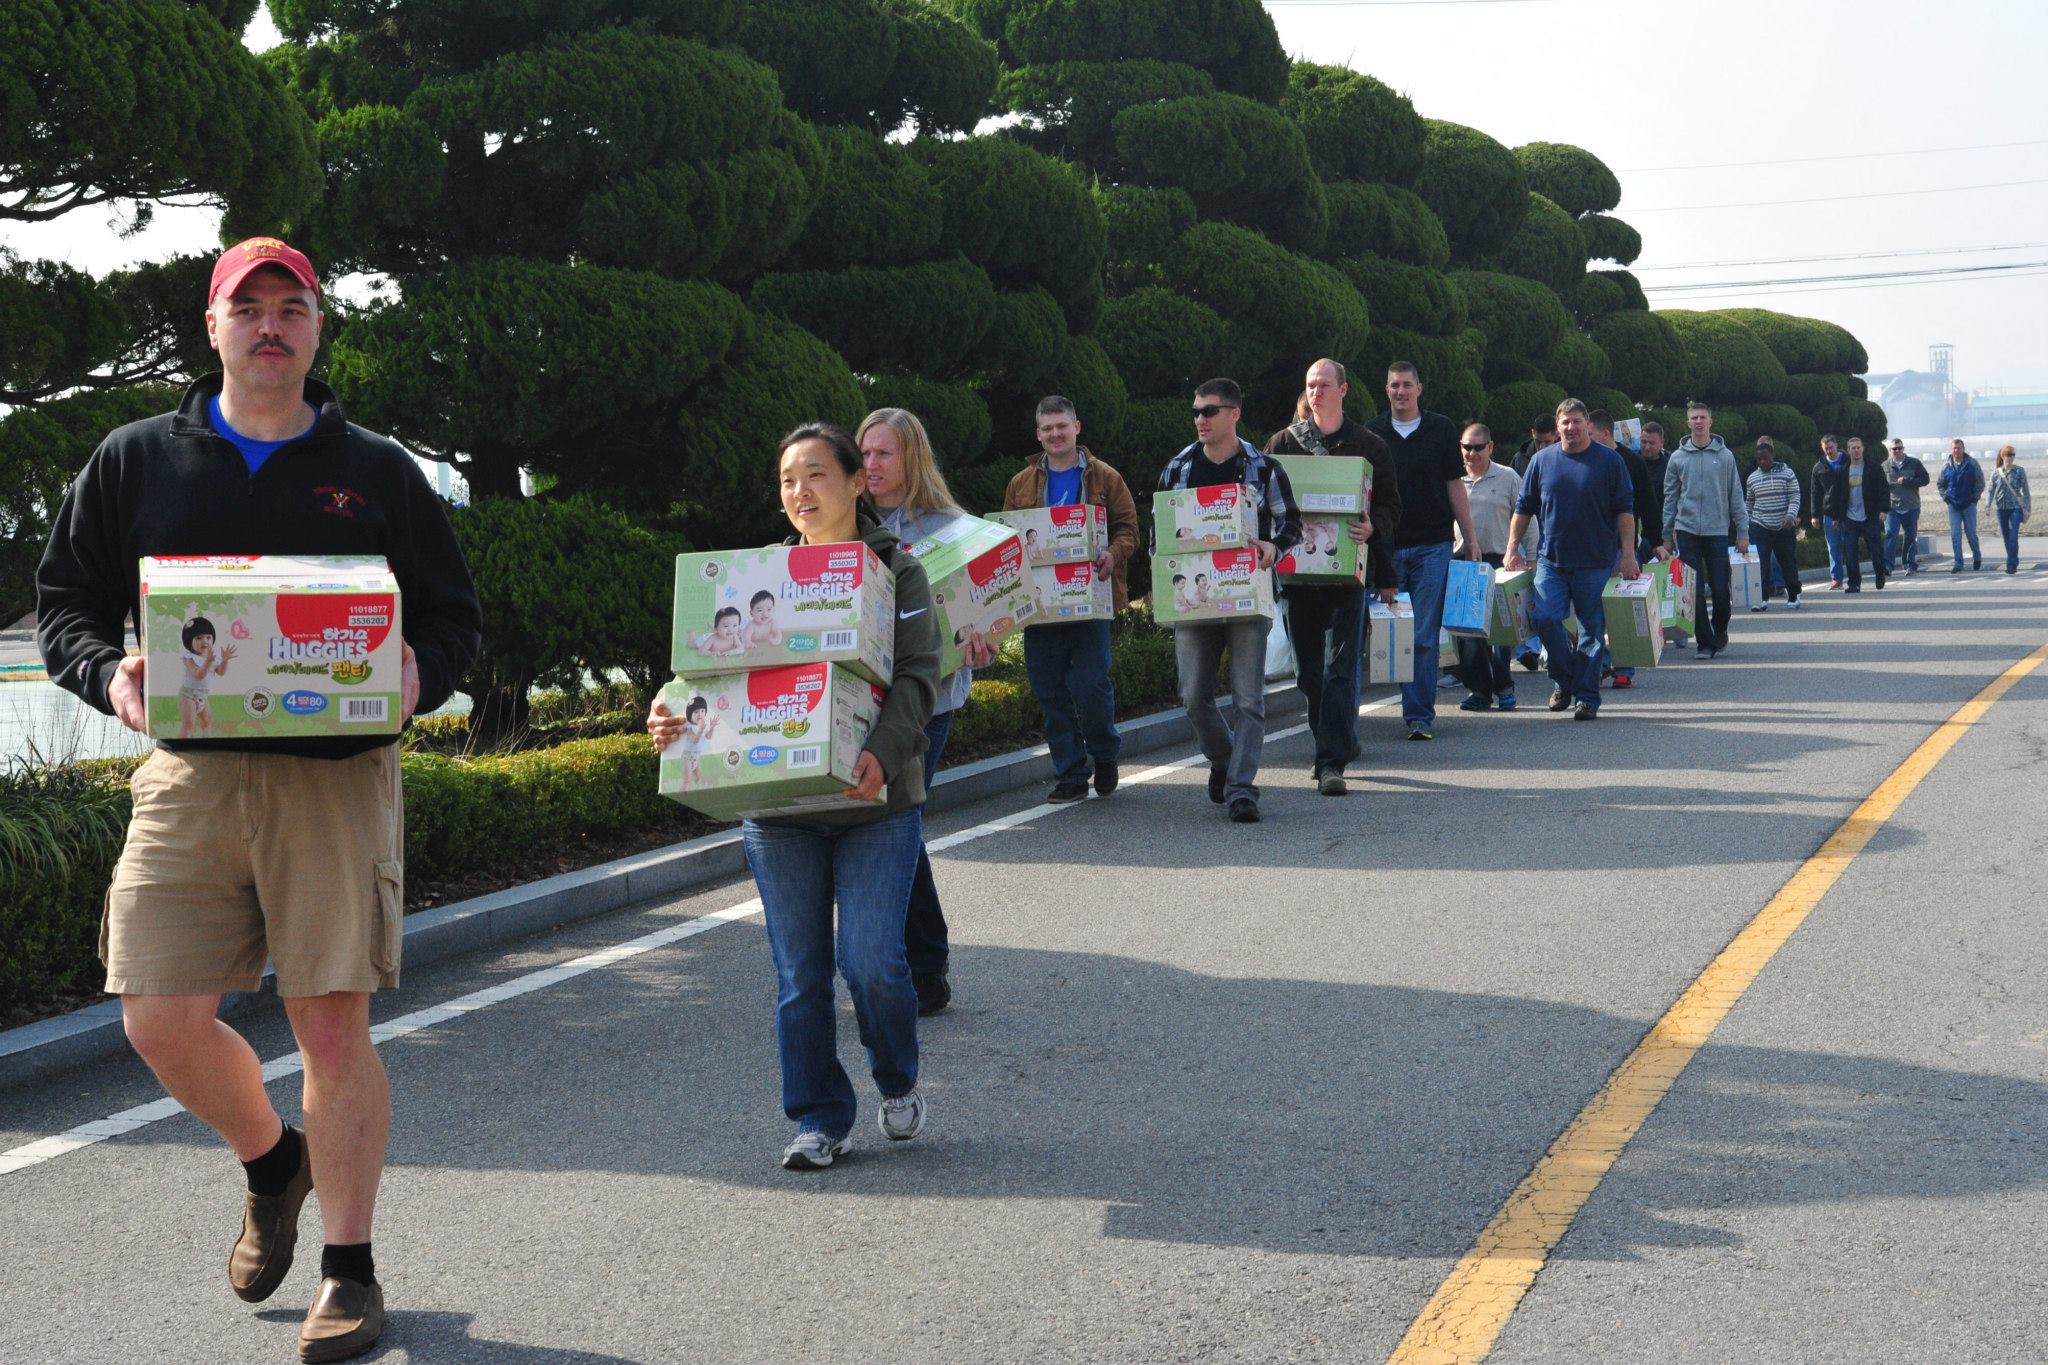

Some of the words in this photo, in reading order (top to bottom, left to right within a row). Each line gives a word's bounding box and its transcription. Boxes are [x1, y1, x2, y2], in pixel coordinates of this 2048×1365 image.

[1194, 504, 1232, 515] HUGGIES
[1050, 523, 1082, 534] HUGGIES
[820, 571, 854, 583] 하기스
[1210, 568, 1250, 580] HUGGIES
[781, 580, 854, 600] HUGGIES
[969, 566, 1019, 603] HUGGIES
[1053, 581, 1087, 592] HUGGIES
[349, 605, 388, 614] 11018877
[351, 617, 386, 625] 3536202
[322, 627, 368, 641] 하기스
[269, 637, 368, 660] HUGGIES
[331, 659, 369, 680] 팬티
[287, 693, 297, 707] 4
[309, 696, 323, 707] 80
[777, 693, 808, 705] 하기스
[741, 702, 808, 723] HUGGIES
[751, 748, 759, 760] 4
